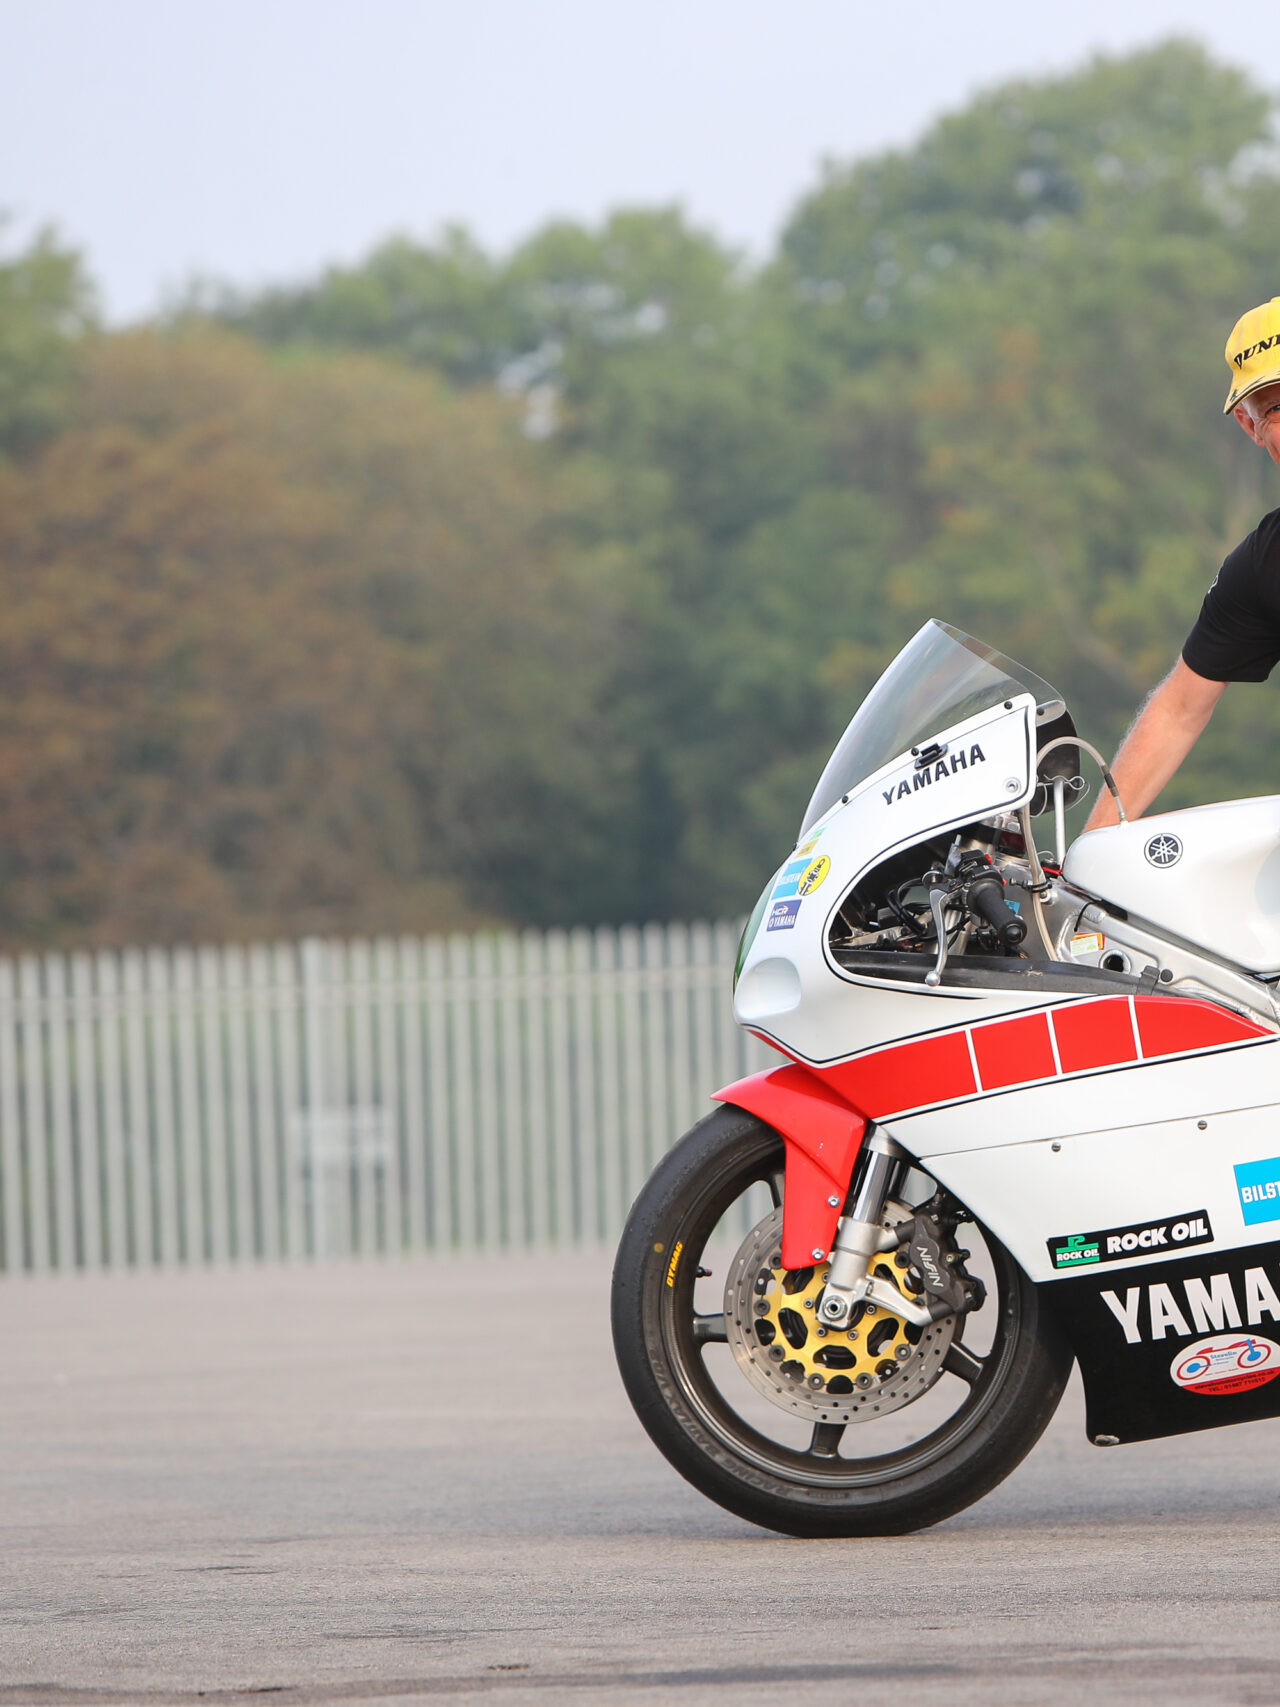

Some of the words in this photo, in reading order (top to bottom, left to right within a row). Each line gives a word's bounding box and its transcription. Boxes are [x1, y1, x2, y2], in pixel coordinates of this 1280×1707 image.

[882, 743, 986, 806] YAMAHA
[1056, 1250, 1083, 1262] ROCK
[1083, 1248, 1099, 1259] OIL
[1106, 1226, 1168, 1254] ROCK
[1171, 1218, 1208, 1241] OIL
[666, 1240, 683, 1288] DYMAG
[916, 1246, 944, 1288] NISSIN
